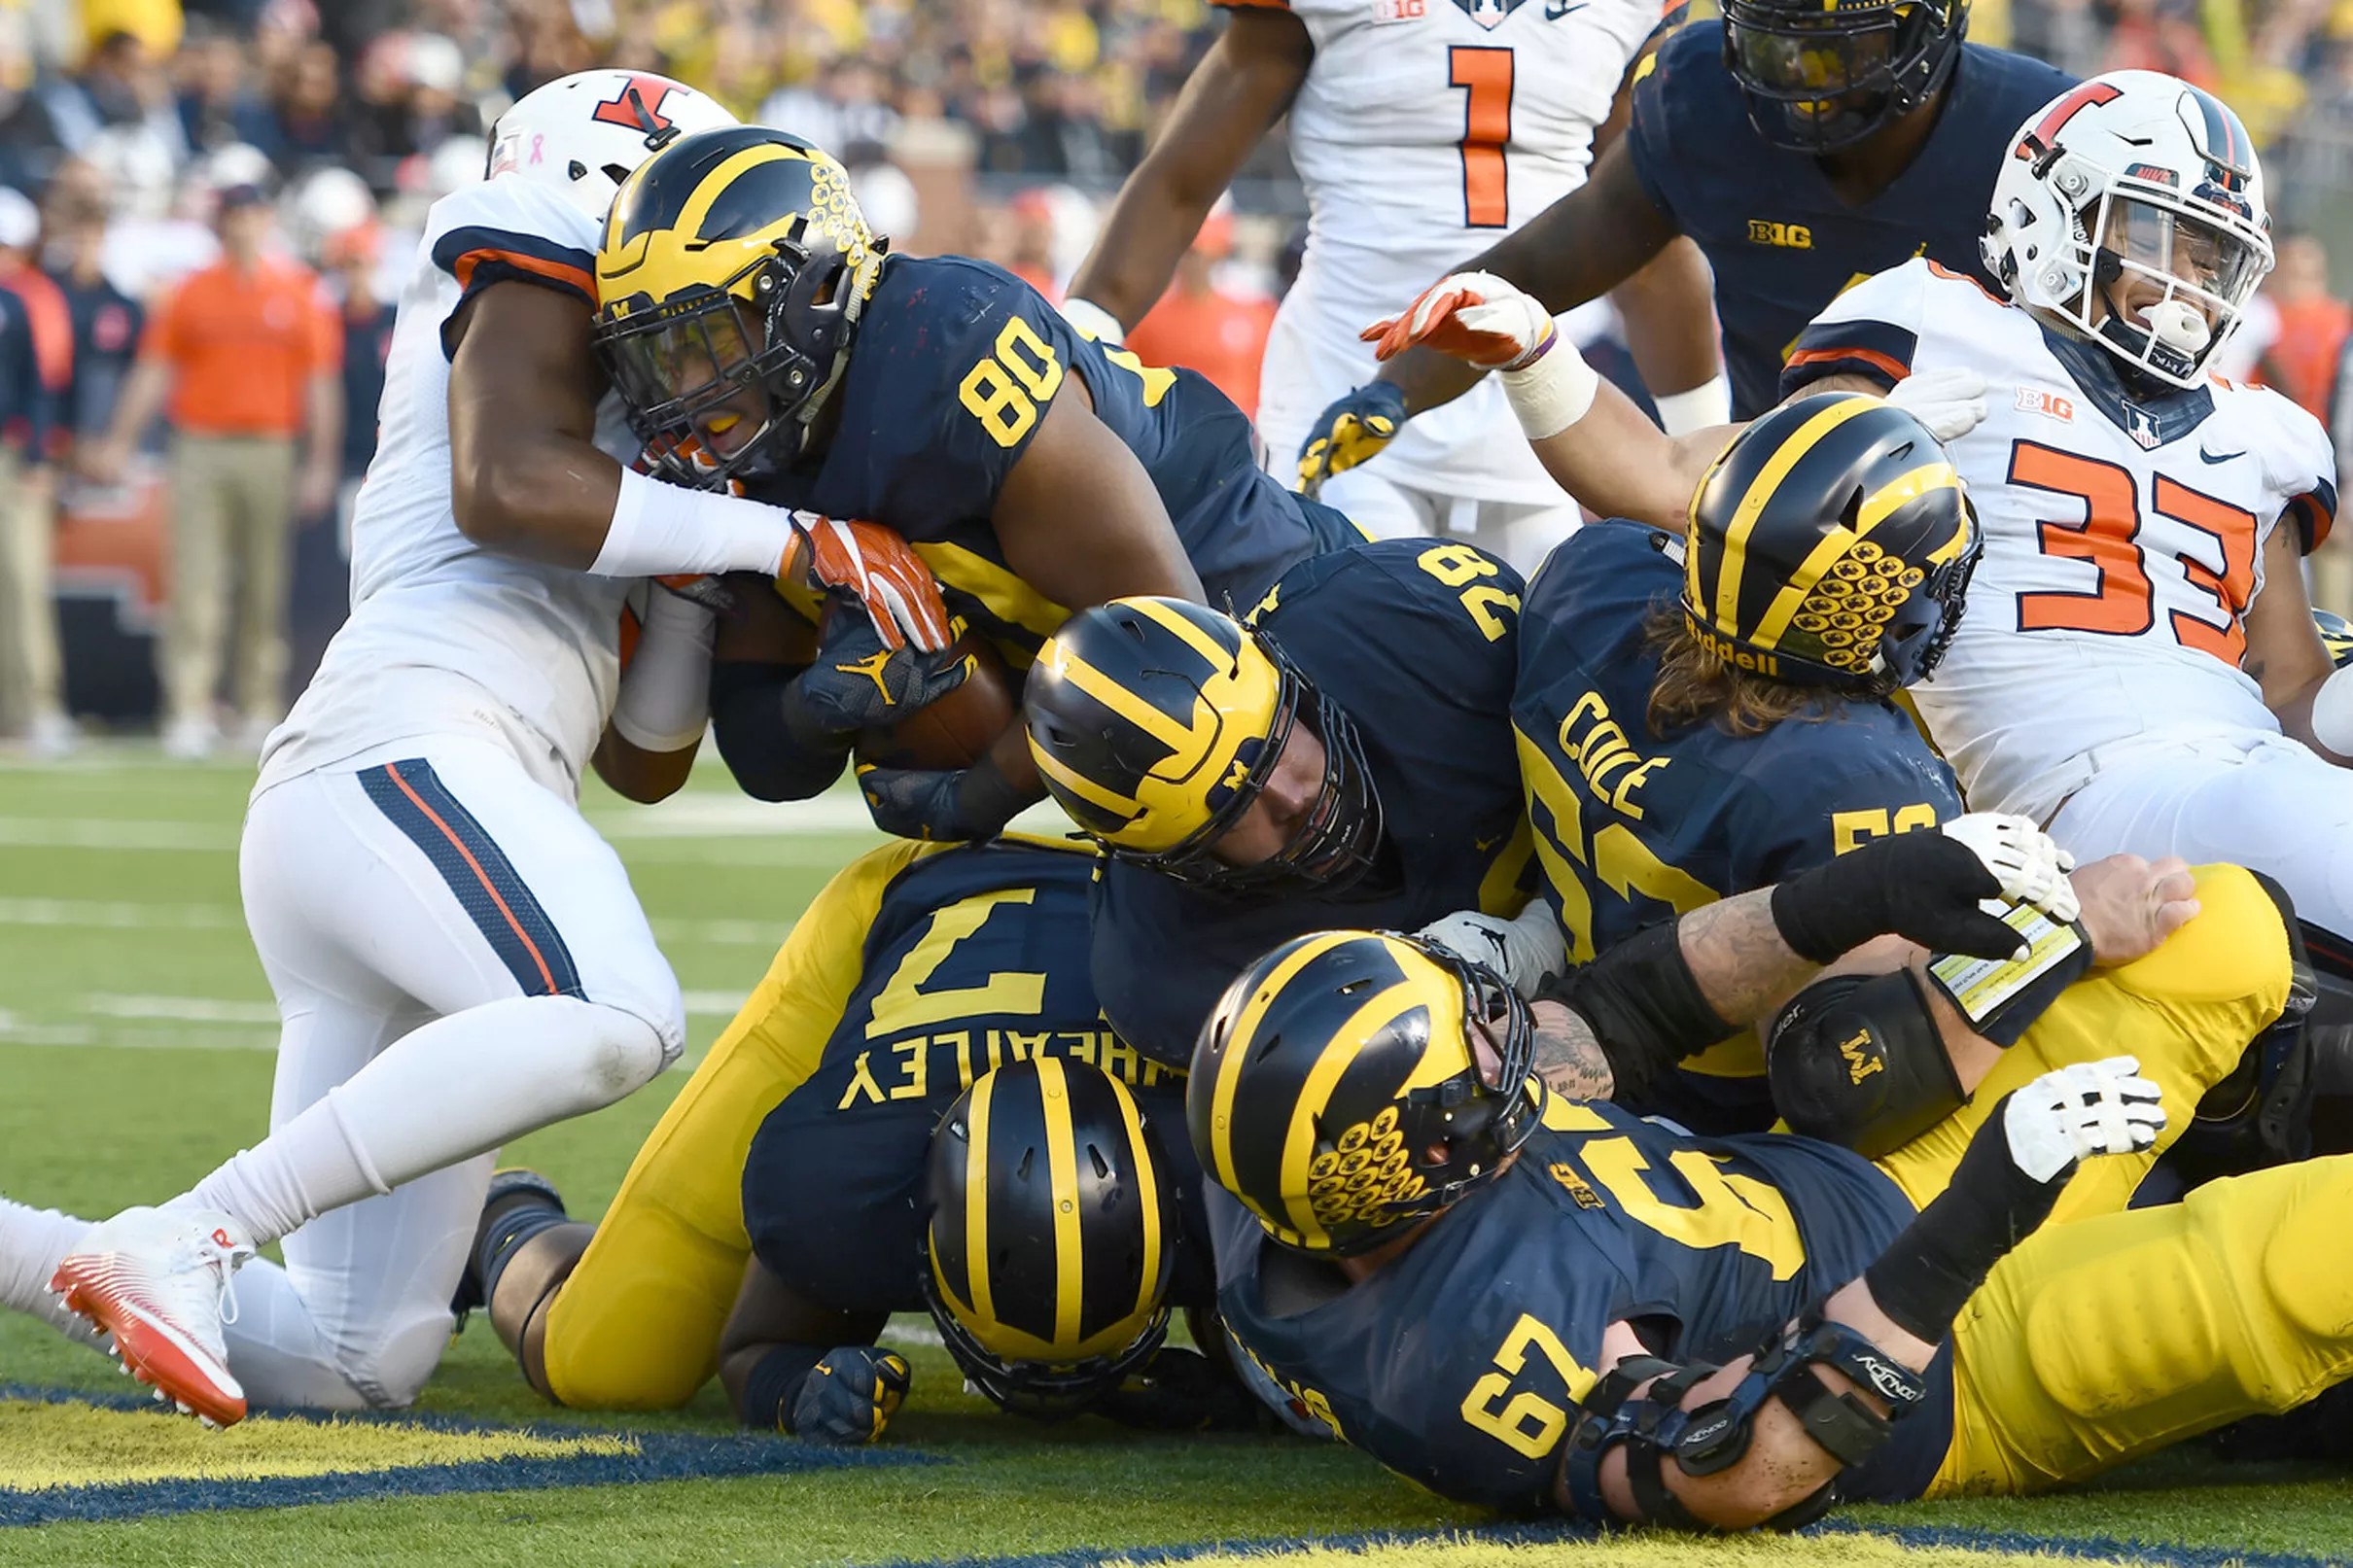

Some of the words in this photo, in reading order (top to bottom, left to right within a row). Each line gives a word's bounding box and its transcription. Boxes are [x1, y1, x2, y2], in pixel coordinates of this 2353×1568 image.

[1448, 44, 1516, 229] 1
[959, 315, 1064, 448] 80
[1417, 544, 1522, 643] 82
[2006, 437, 2259, 669] 33
[1684, 612, 1778, 677] Riddell
[1558, 690, 1672, 820] COLE
[1840, 1028, 1883, 1086] M
[1460, 1312, 1598, 1460] 67
